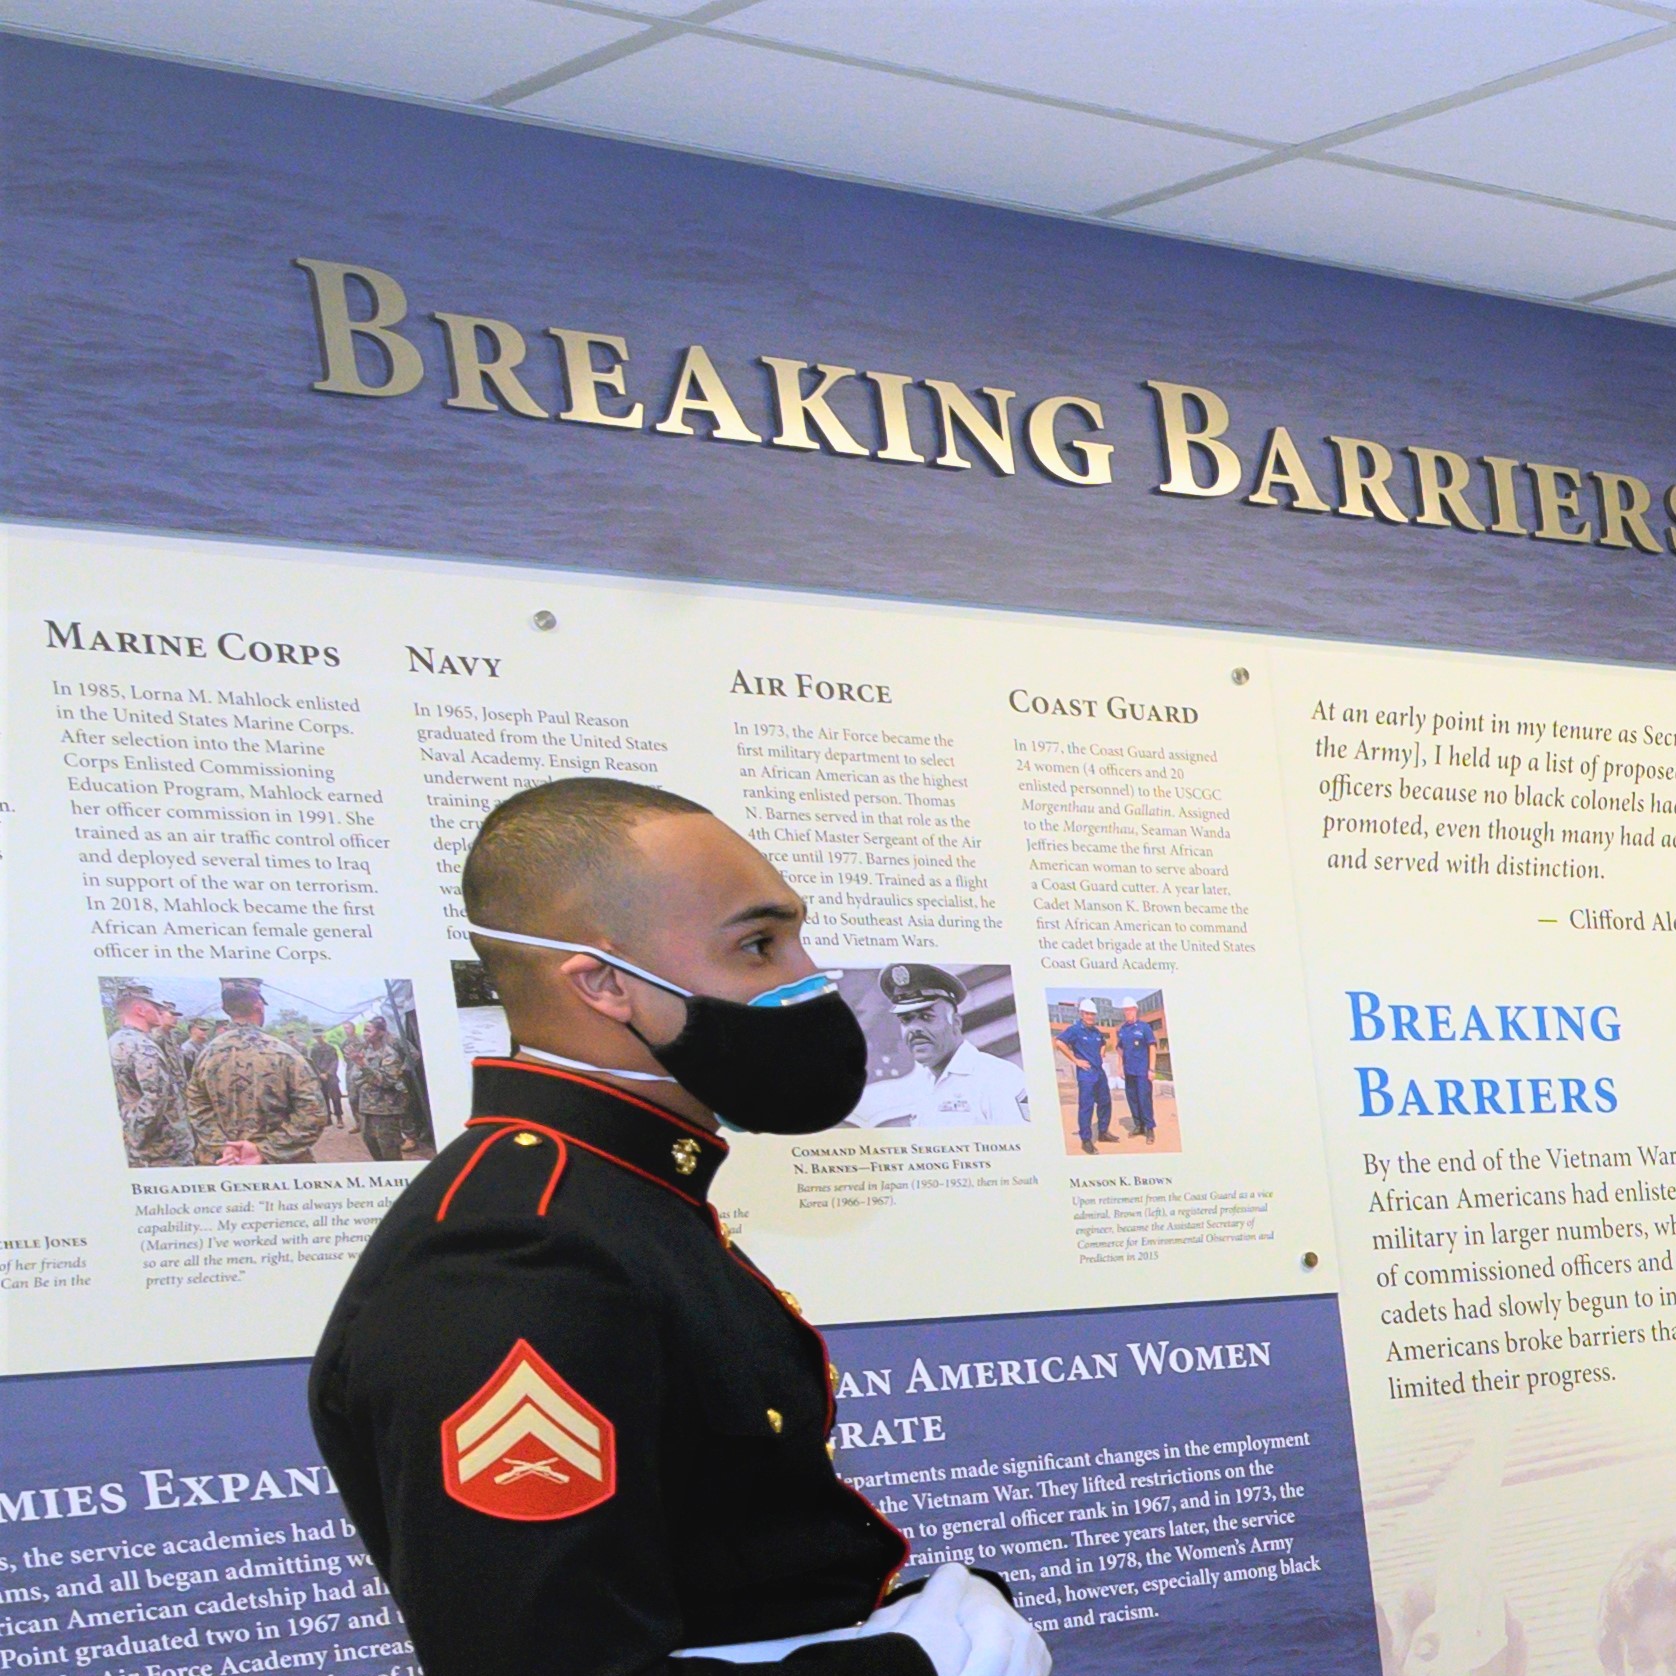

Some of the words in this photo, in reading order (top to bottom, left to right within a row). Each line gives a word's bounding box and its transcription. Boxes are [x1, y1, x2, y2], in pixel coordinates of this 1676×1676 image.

[293, 257, 1115, 486] BREAKING
[44, 619, 206, 658] MARINE
[217, 632, 340, 667] CORPS
[405, 645, 501, 678] NAVY
[52, 680, 72, 695] In
[79, 682, 125, 700] 1985,
[130, 684, 183, 702] Lorna
[188, 688, 212, 704] M.
[217, 690, 292, 708] Mahlock
[296, 695, 360, 712] enlisted
[730, 669, 787, 697] AIR
[795, 673, 892, 704] FORCE
[1009, 689, 1097, 718] COAST
[1106, 695, 1198, 724] GUARD
[1311, 699, 1335, 721] At
[1342, 707, 1368, 723] an
[1375, 705, 1426, 734] early
[1432, 710, 1484, 736] point
[1491, 713, 1510, 734] in
[1517, 721, 1546, 743] my
[1552, 720, 1612, 742] tenure
[1618, 729, 1637, 744] as
[733, 721, 749, 735] In
[754, 723, 789, 738] 1973,
[792, 724, 813, 739] the
[818, 727, 839, 740] Air
[842, 727, 878, 743] Force
[881, 729, 930, 746] became
[933, 733, 954, 747] the
[1013, 738, 1027, 751] In
[1031, 740, 1064, 754] 1977,
[1067, 741, 1086, 755] the
[1089, 743, 1124, 757] Coast
[1127, 745, 1165, 760] Guard
[1168, 749, 1218, 765] assigned
[1569, 908, 1645, 931] Clifford
[1344, 991, 1621, 1042] BREAKING
[1353, 1067, 1617, 1117] BARRIERS
[1362, 1153, 1390, 1182] By
[1398, 1150, 1431, 1174] the
[1437, 1149, 1476, 1172] end
[1482, 1147, 1504, 1171] of
[1509, 1147, 1540, 1170] the
[1545, 1148, 1632, 1168] Vietnam
[1637, 1145, 1676, 1166] War
[131, 1183, 216, 1195] BRIGADIER
[220, 1180, 289, 1192] GENERAL
[293, 1178, 343, 1190] LORNA
[346, 1176, 365, 1188] M.
[905, 1352, 1118, 1394] AMERICAN
[1126, 1340, 1270, 1376] WOMEN
[879, 1496, 908, 1513] the
[911, 1491, 989, 1510] Vietnam
[992, 1484, 1033, 1502] War.
[1036, 1479, 1078, 1498] They
[1081, 1472, 1126, 1493] lifted
[1130, 1467, 1221, 1488] restrictions
[1224, 1466, 1245, 1479] on
[1248, 1459, 1274, 1477] the
[1, 1645, 69, 1669] Point
[75, 1627, 200, 1667] graduated
[205, 1628, 250, 1646] two
[255, 1621, 280, 1640] in
[287, 1612, 340, 1636] 1967
[347, 1606, 391, 1629] and
